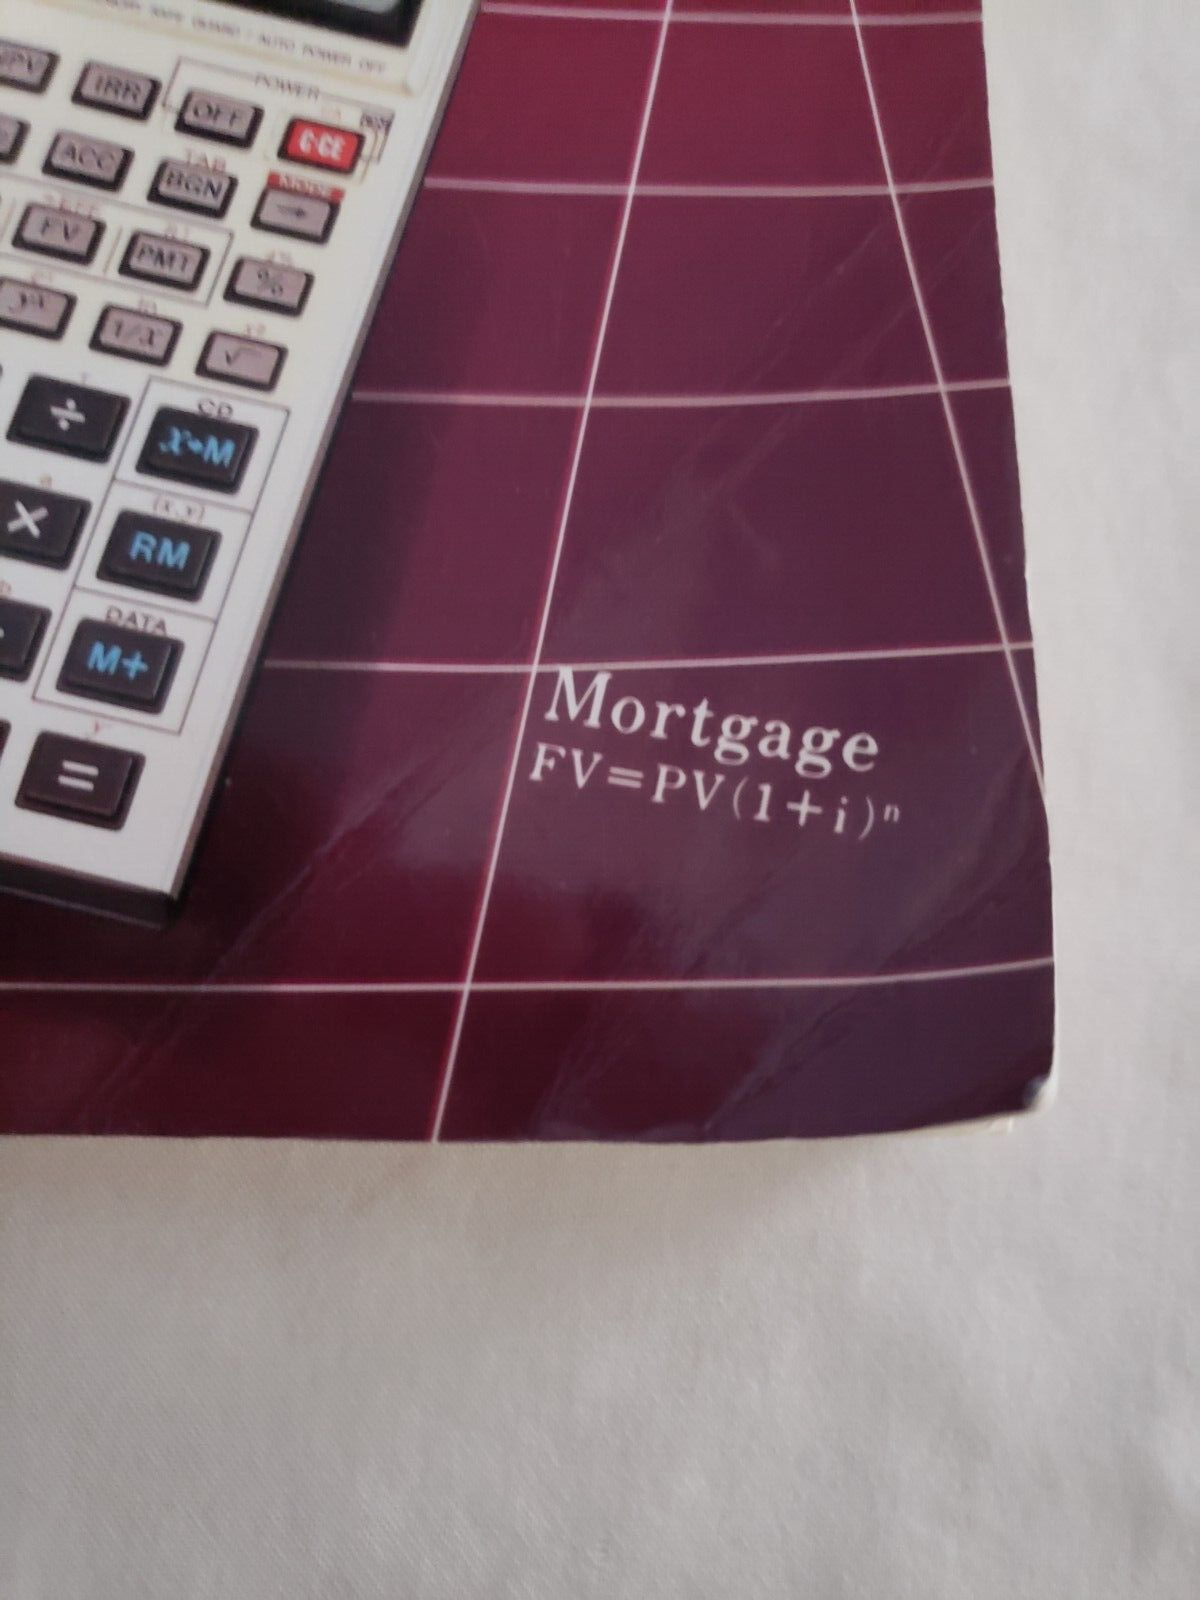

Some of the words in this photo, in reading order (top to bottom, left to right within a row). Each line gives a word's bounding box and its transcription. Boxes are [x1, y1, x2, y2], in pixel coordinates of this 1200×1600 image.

[254, 71, 320, 101] POWER
[191, 102, 243, 129] OFF
[164, 169, 225, 201] BGN
[129, 530, 191, 571] RM
[104, 605, 169, 635] DATA
[86, 640, 149, 681] M+
[544, 665, 880, 780] Mortgage
